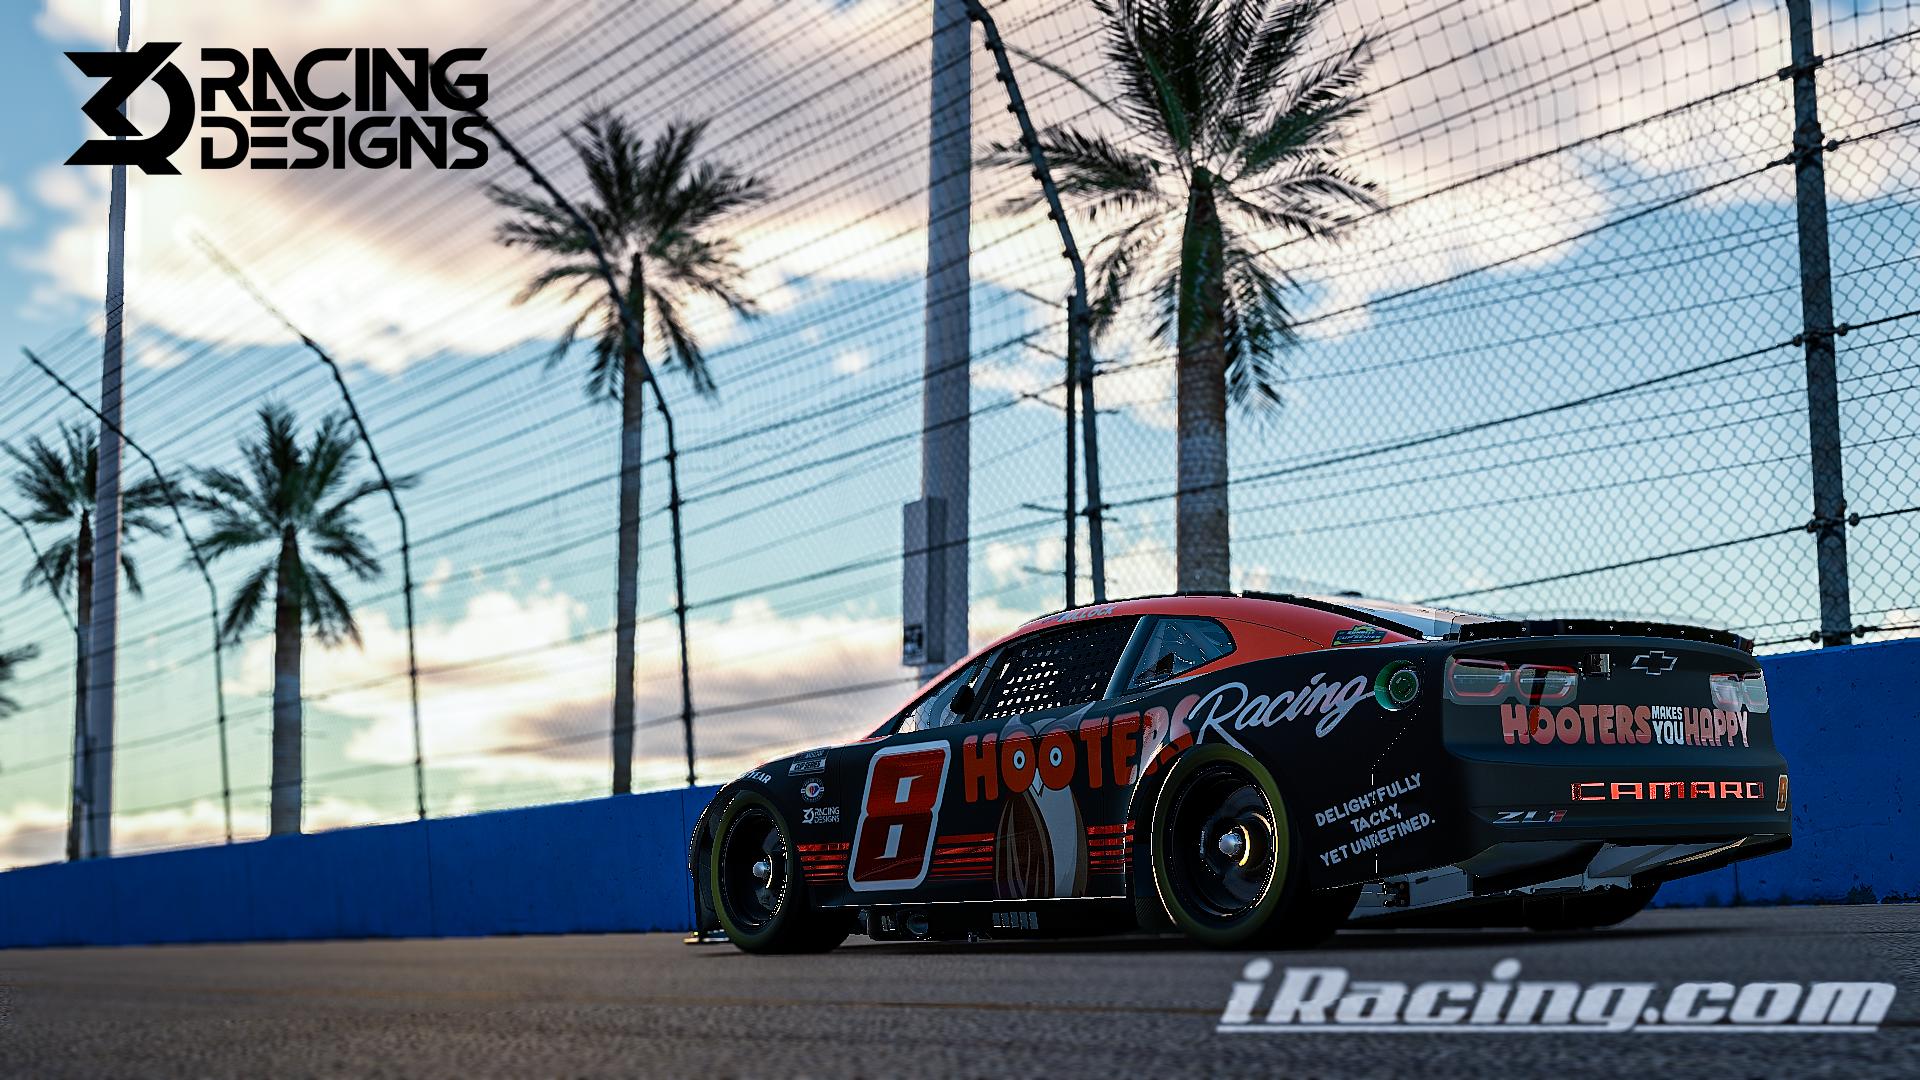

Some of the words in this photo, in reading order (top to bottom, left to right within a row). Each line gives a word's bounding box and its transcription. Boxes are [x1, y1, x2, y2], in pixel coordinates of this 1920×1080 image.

[1189, 673, 1375, 756] Racing
[1501, 704, 1651, 745] HOOTERS
[1651, 705, 1683, 720] MAKES
[1684, 707, 1750, 748] HAPPY
[962, 694, 1201, 803] HOOTERS
[1652, 720, 1685, 745] YOU
[1315, 772, 1421, 827] DELIGHTFULLY
[1571, 781, 1764, 801] CAMARO
[815, 806, 840, 816] RACING
[815, 815, 840, 824] DESIGNS
[848, 740, 951, 892] 8
[1350, 803, 1402, 833] TACKY,
[1492, 809, 1568, 824] ZL1
[1320, 845, 1348, 867] YET
[1350, 812, 1436, 855] UNREFINED.
